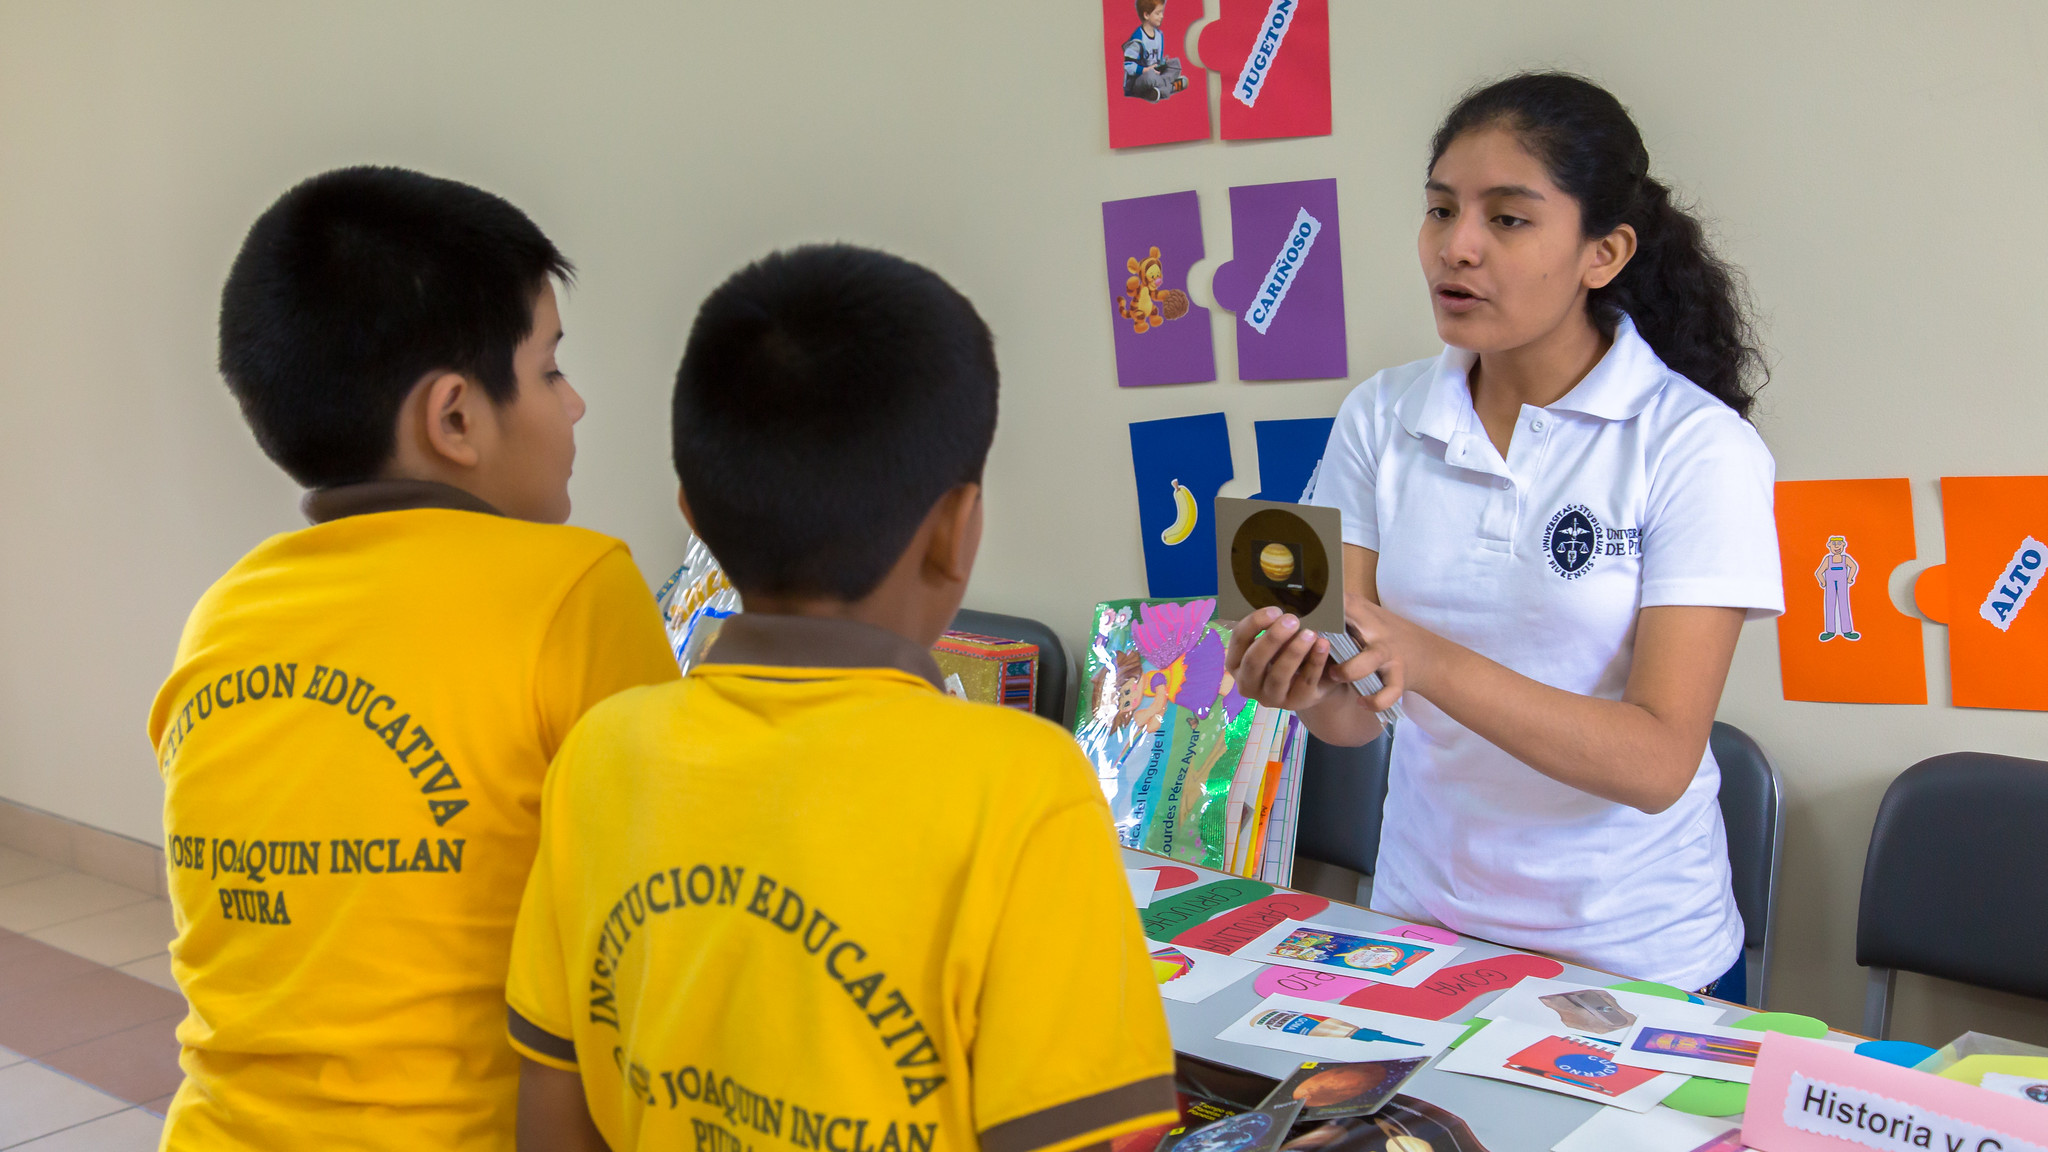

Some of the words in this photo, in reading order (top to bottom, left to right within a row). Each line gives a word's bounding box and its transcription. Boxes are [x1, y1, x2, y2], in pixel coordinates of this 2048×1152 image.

[1252, 222, 1312, 324] CARIÑOSO
[1542, 503, 1573, 552] UNIVERSITAS
[1605, 542, 1626, 555] DE
[1548, 560, 1594, 580] PIURENSIS
[1991, 549, 2042, 622] ALTO
[164, 663, 298, 768] TITUCION
[302, 664, 470, 827] EDUCATIVA
[1168, 767, 1188, 801] Pérez
[1181, 729, 1200, 765] Ayvar
[1130, 823, 1142, 847] tica
[1138, 740, 1164, 796] lenguaje
[211, 839, 321, 883] JOAQUIN
[329, 838, 466, 874] INCLAN
[218, 888, 292, 925] PIURA
[1201, 902, 1300, 954] CARTULINA
[589, 864, 745, 1032] INSTITUCION
[746, 874, 947, 1107] EDUCATIVA
[1425, 967, 1508, 997] GOMA
[1558, 1055, 1617, 1078] CUADERNO
[660, 1066, 784, 1138] JOAQUIN
[790, 1105, 938, 1152] INCLAN
[1802, 1085, 1932, 1149] Historia
